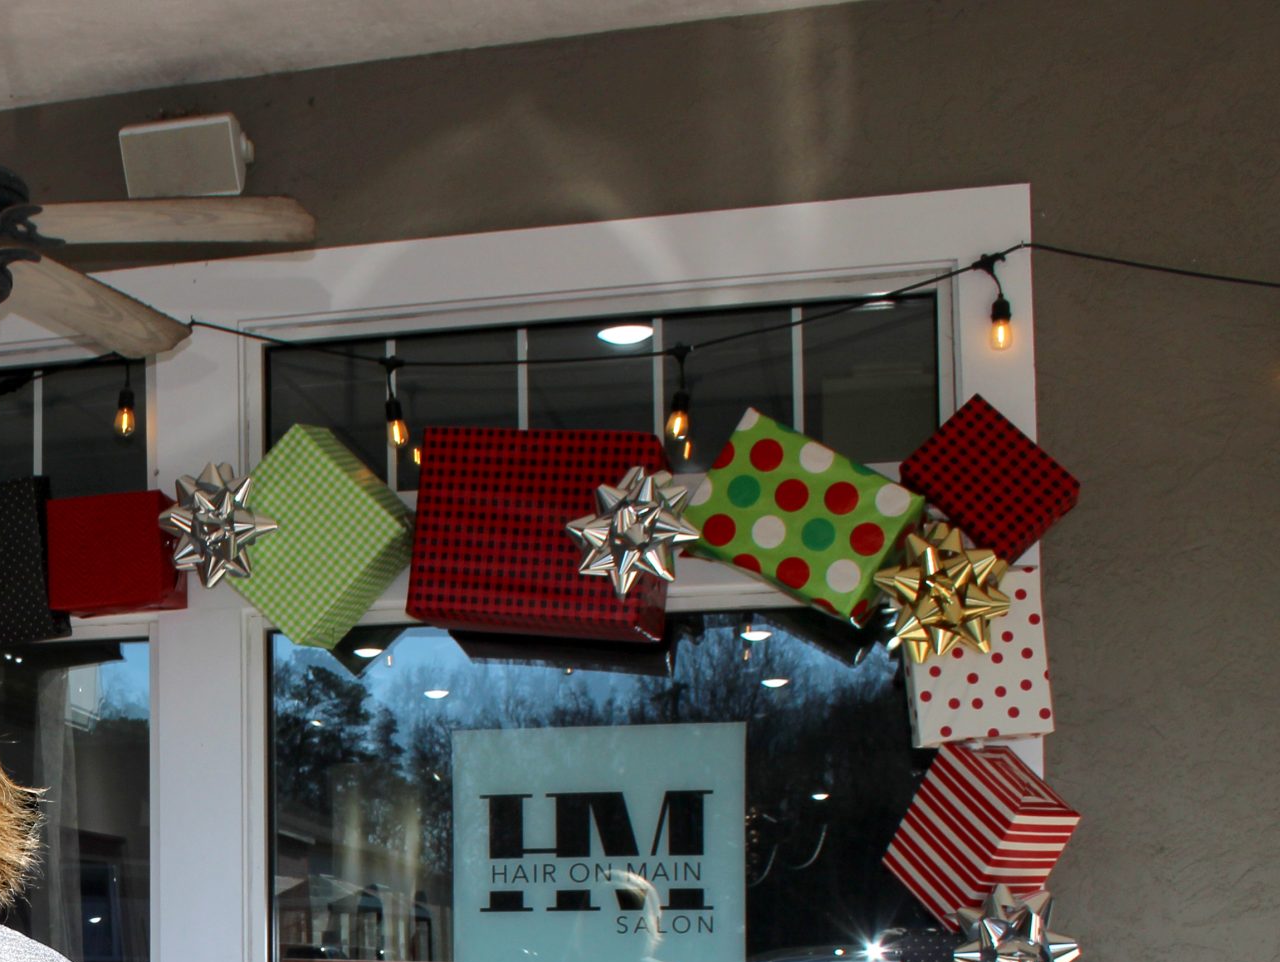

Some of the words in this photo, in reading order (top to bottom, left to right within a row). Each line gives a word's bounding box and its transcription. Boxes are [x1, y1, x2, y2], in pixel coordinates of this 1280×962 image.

[491, 863, 557, 883] HAIR
[569, 862, 612, 882] ON
[626, 861, 702, 882] MAIN
[615, 914, 714, 934] SALON
